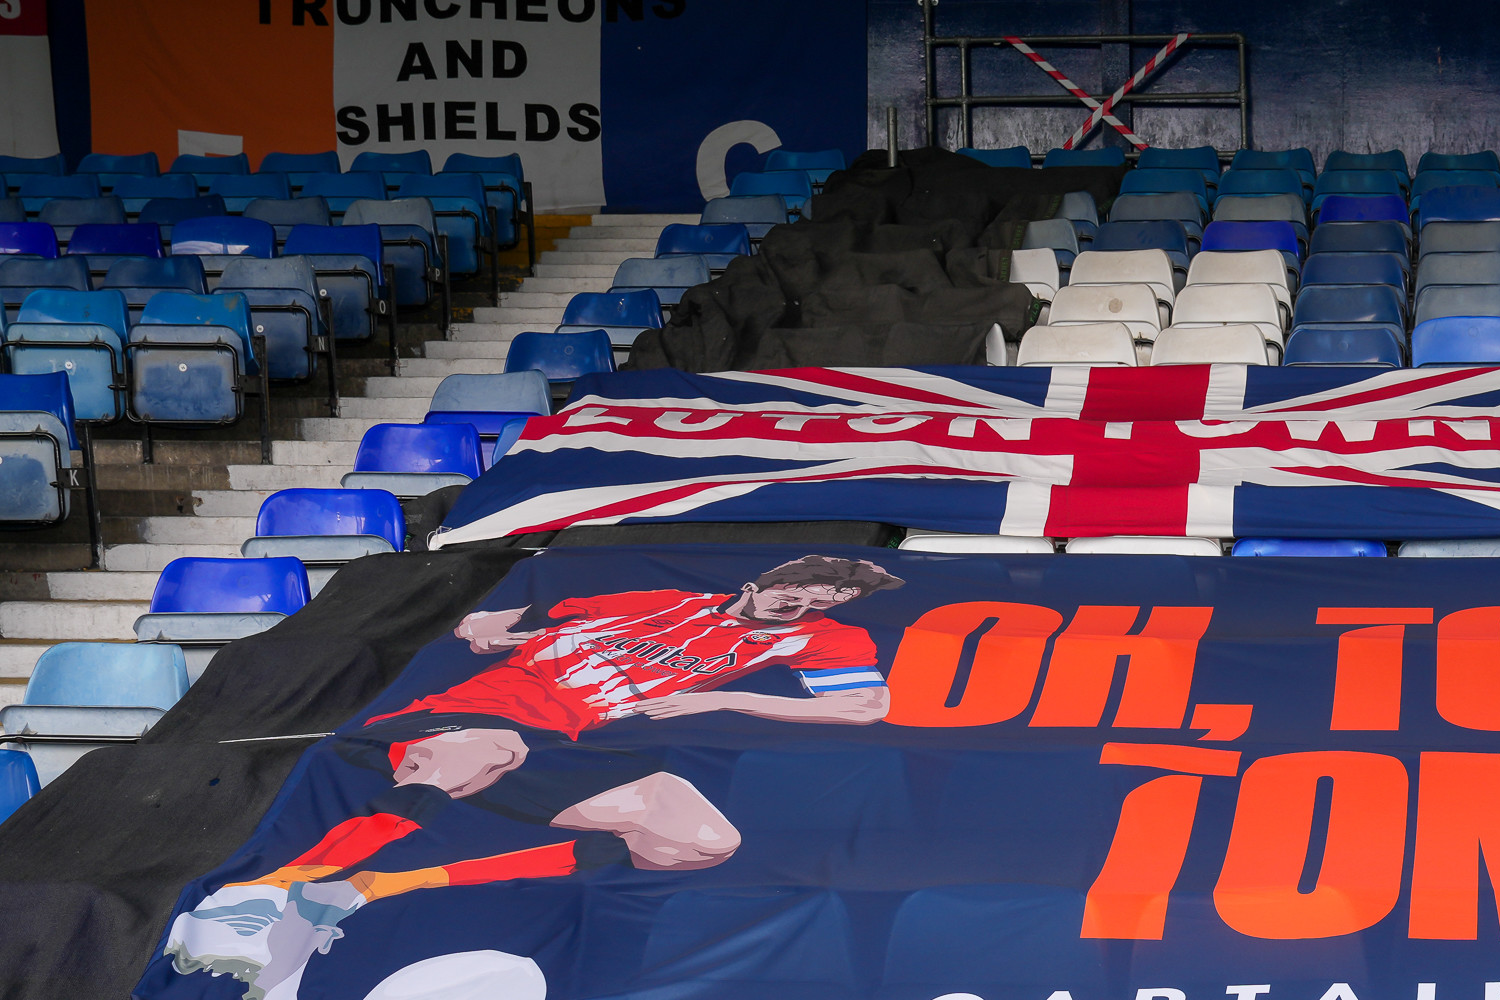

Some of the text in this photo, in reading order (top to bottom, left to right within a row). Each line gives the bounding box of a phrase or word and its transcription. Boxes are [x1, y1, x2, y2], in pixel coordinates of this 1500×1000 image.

[396, 39, 528, 82] AND
[336, 101, 601, 146] SHIELDS
[69, 469, 80, 487] K
[881, 600, 1254, 741] OH,
